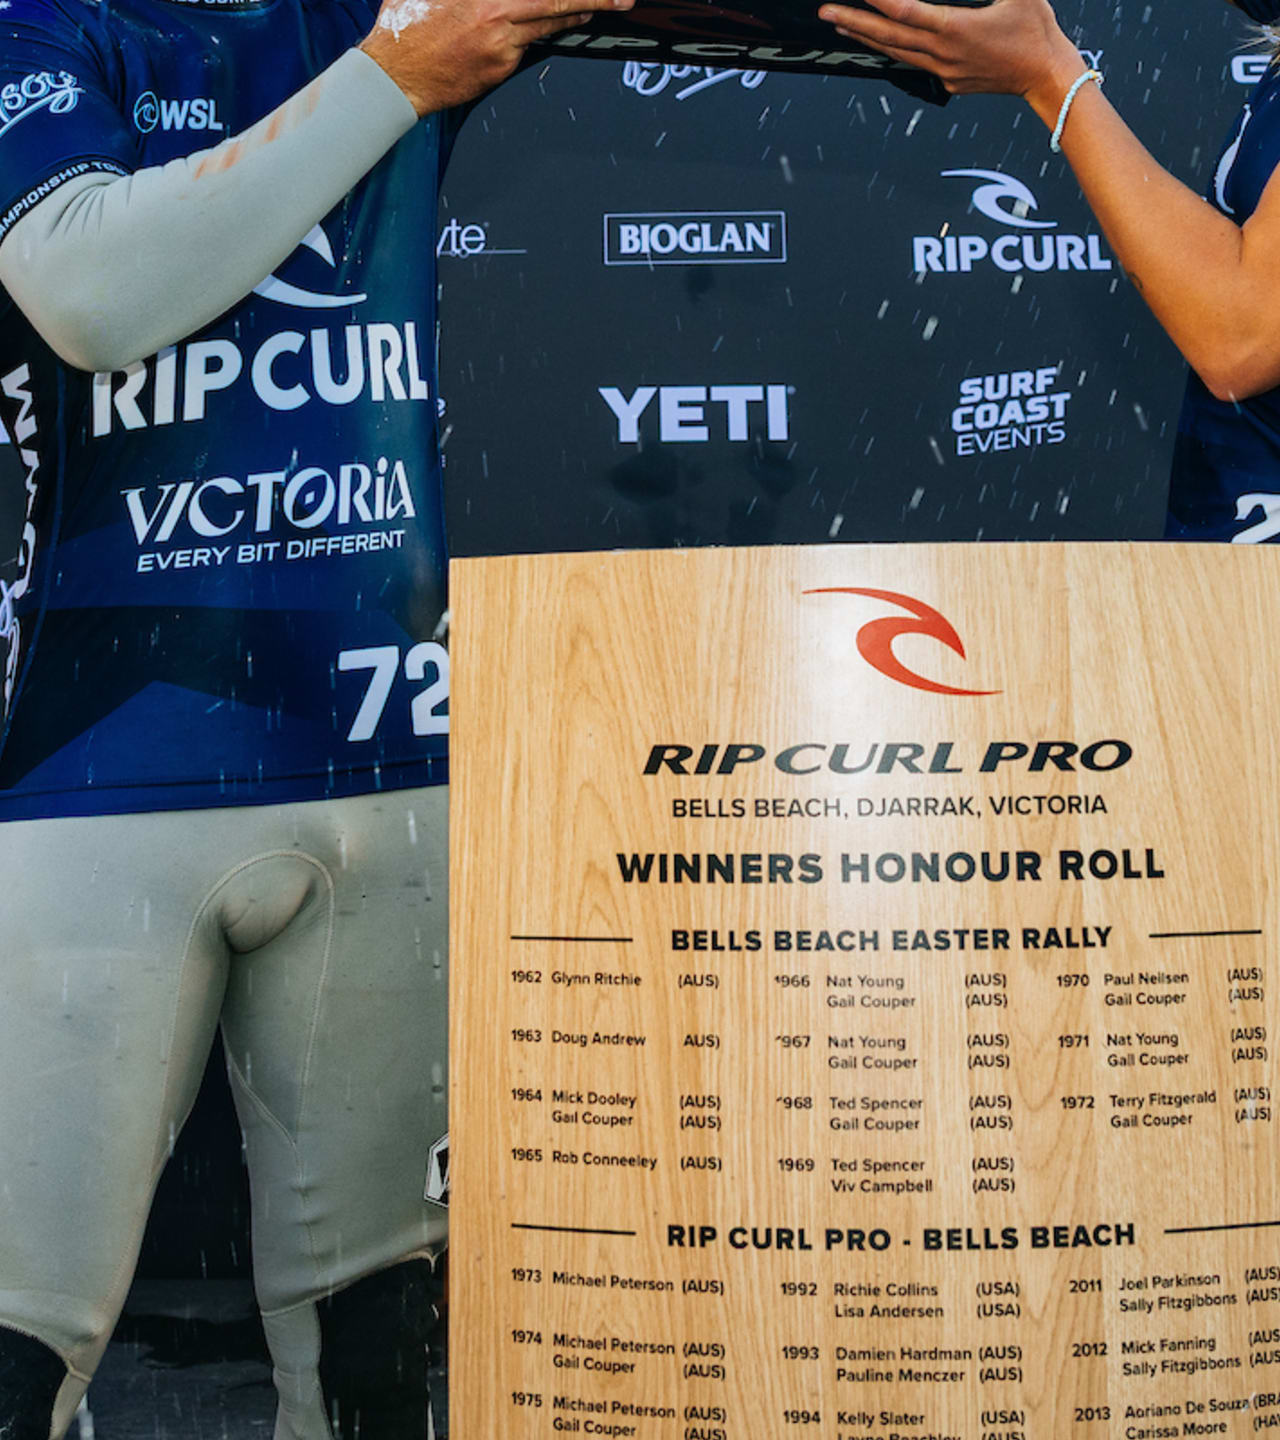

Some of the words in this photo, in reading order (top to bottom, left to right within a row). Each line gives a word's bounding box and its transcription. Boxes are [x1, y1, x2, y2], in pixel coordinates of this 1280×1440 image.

[161, 98, 224, 131] WSL
[619, 221, 771, 255] BIOGLAN
[914, 237, 988, 272] RIP
[988, 235, 1112, 271] CURL
[251, 321, 429, 411] CURL
[960, 368, 1058, 403] SURF
[600, 386, 788, 443] YETI
[952, 394, 1071, 431] COAST
[956, 422, 1066, 456] EVENTS
[136, 545, 234, 573] EVERY
[236, 542, 282, 564] BIT
[285, 530, 405, 560] DIFFERENT
[338, 641, 449, 742] 72
[643, 743, 766, 776] RIP
[775, 740, 963, 776] CURL
[979, 738, 1133, 772] PRO
[671, 797, 746, 819] BELLS
[754, 797, 849, 820] BEACH,
[857, 795, 983, 820] DJARRAK,
[990, 794, 1108, 817] VICTORIA
[617, 852, 824, 885] WINNERS
[840, 851, 1043, 884] HONOUR
[1059, 848, 1166, 880] ROLL
[670, 929, 763, 953] BELLS
[773, 928, 882, 953] BEACH
[890, 927, 1012, 952] EASTER
[1022, 925, 1113, 950] RALLY
[511, 970, 543, 984] 1962
[551, 971, 590, 988] Glynn
[594, 972, 642, 986] Ritchie
[677, 973, 720, 989] (AUS)
[1056, 974, 1090, 988] 1970
[1104, 973, 1134, 987] Paul
[1227, 967, 1264, 983] (AUS)
[1105, 993, 1132, 1007] Gail
[1136, 992, 1187, 1008] Couper
[511, 1029, 543, 1043] 1963
[552, 1030, 587, 1047] Doug
[592, 1032, 647, 1047] Andrew
[511, 1088, 543, 1102] 1964
[552, 1090, 583, 1104] Mick
[587, 1092, 637, 1109] Dooley
[679, 1094, 722, 1110] (AUS)
[552, 1110, 578, 1124] Gail
[582, 1112, 634, 1128] Couper
[679, 1114, 722, 1130] (AUS)
[511, 1148, 543, 1162] 1965
[552, 1150, 578, 1164] Rob
[680, 1155, 722, 1171] (AUS)
[668, 1224, 717, 1248] RIP
[728, 1226, 812, 1251] CURL
[825, 1229, 892, 1252] PRO
[923, 1227, 1019, 1252] BELLS
[1030, 1223, 1136, 1249] BEACH
[511, 1268, 543, 1283] 1973
[552, 1271, 606, 1288] Michael
[610, 1274, 674, 1292] Peterson
[681, 1278, 725, 1295] (AUS)
[1069, 1279, 1103, 1293] 2011
[1119, 1277, 1148, 1291] Joel
[1152, 1272, 1220, 1289] Parkinson
